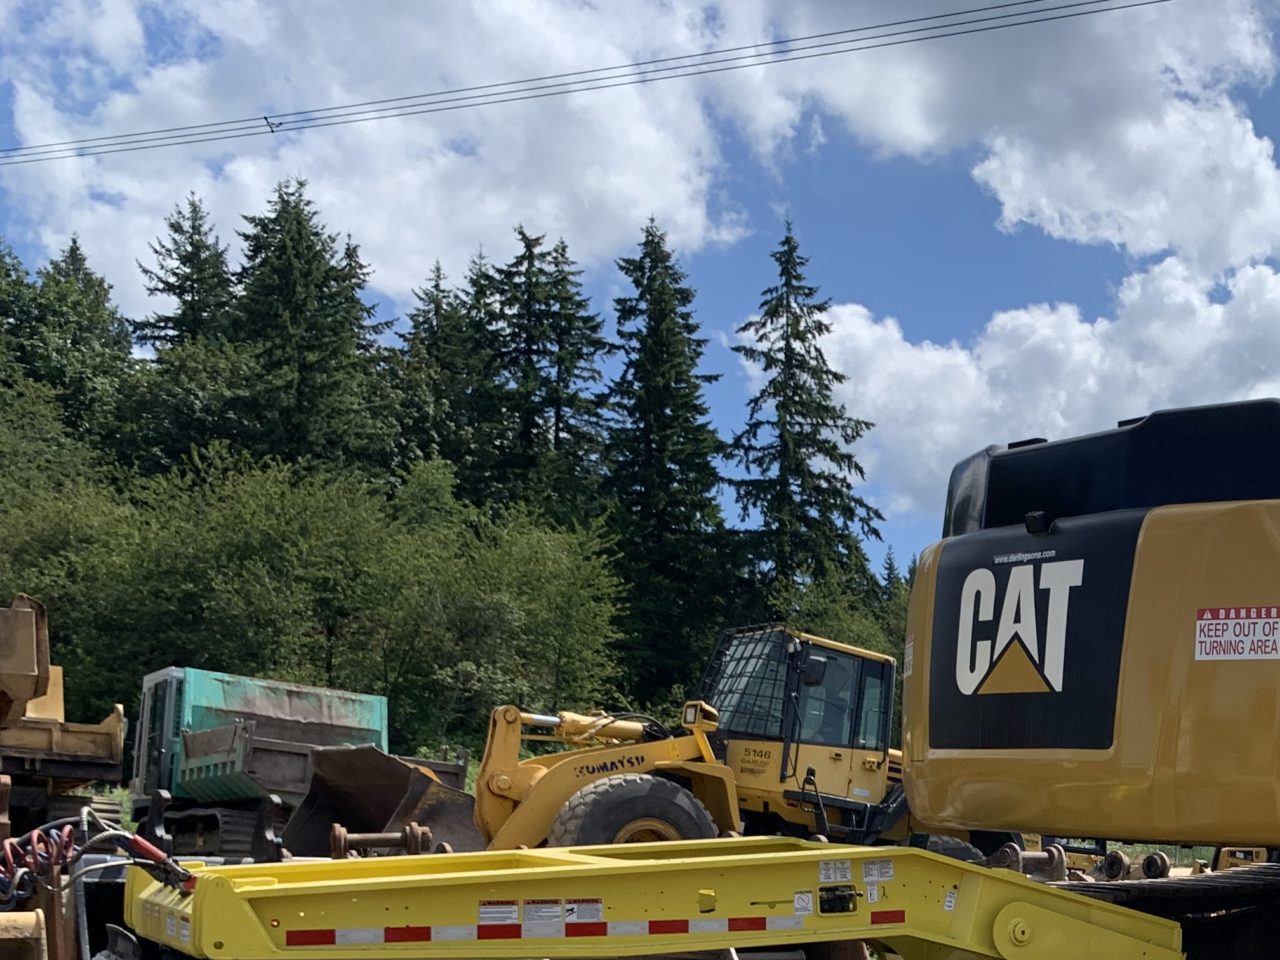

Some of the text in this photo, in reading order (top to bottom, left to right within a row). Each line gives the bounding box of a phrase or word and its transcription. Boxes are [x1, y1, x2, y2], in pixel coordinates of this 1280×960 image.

[1219, 608, 1278, 619] DANGER
[956, 558, 1085, 696] CAT
[1199, 621, 1279, 638] KEEP OUT OF
[1198, 639, 1278, 656] TURNING AREA
[744, 747, 771, 760] 5146
